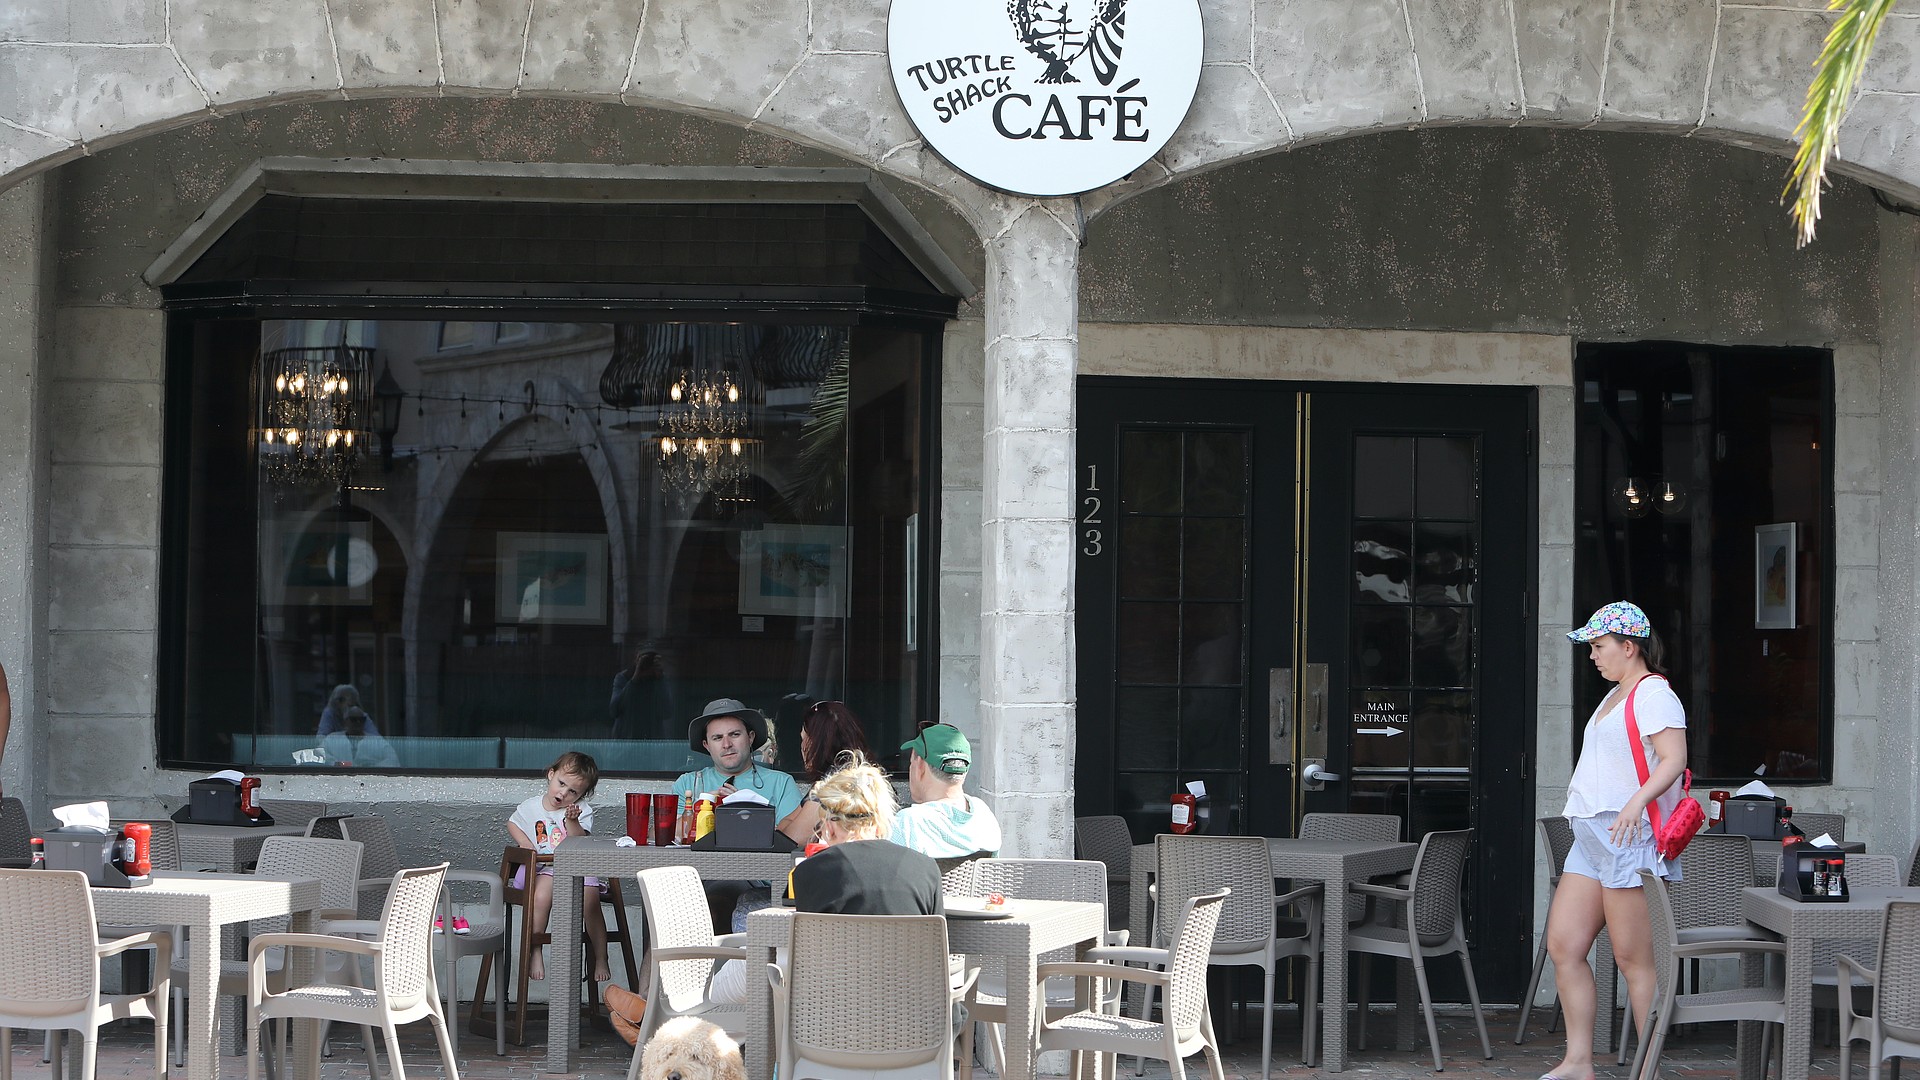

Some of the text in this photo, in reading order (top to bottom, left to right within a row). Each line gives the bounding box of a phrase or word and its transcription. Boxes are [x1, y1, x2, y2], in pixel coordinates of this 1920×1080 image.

[907, 54, 1016, 92] TURTLE
[933, 75, 1013, 123] SHACK
[992, 77, 1149, 142] CAFÉ
[1353, 713, 1409, 723] ENTRANCE
[1367, 702, 1395, 711] MAIN
